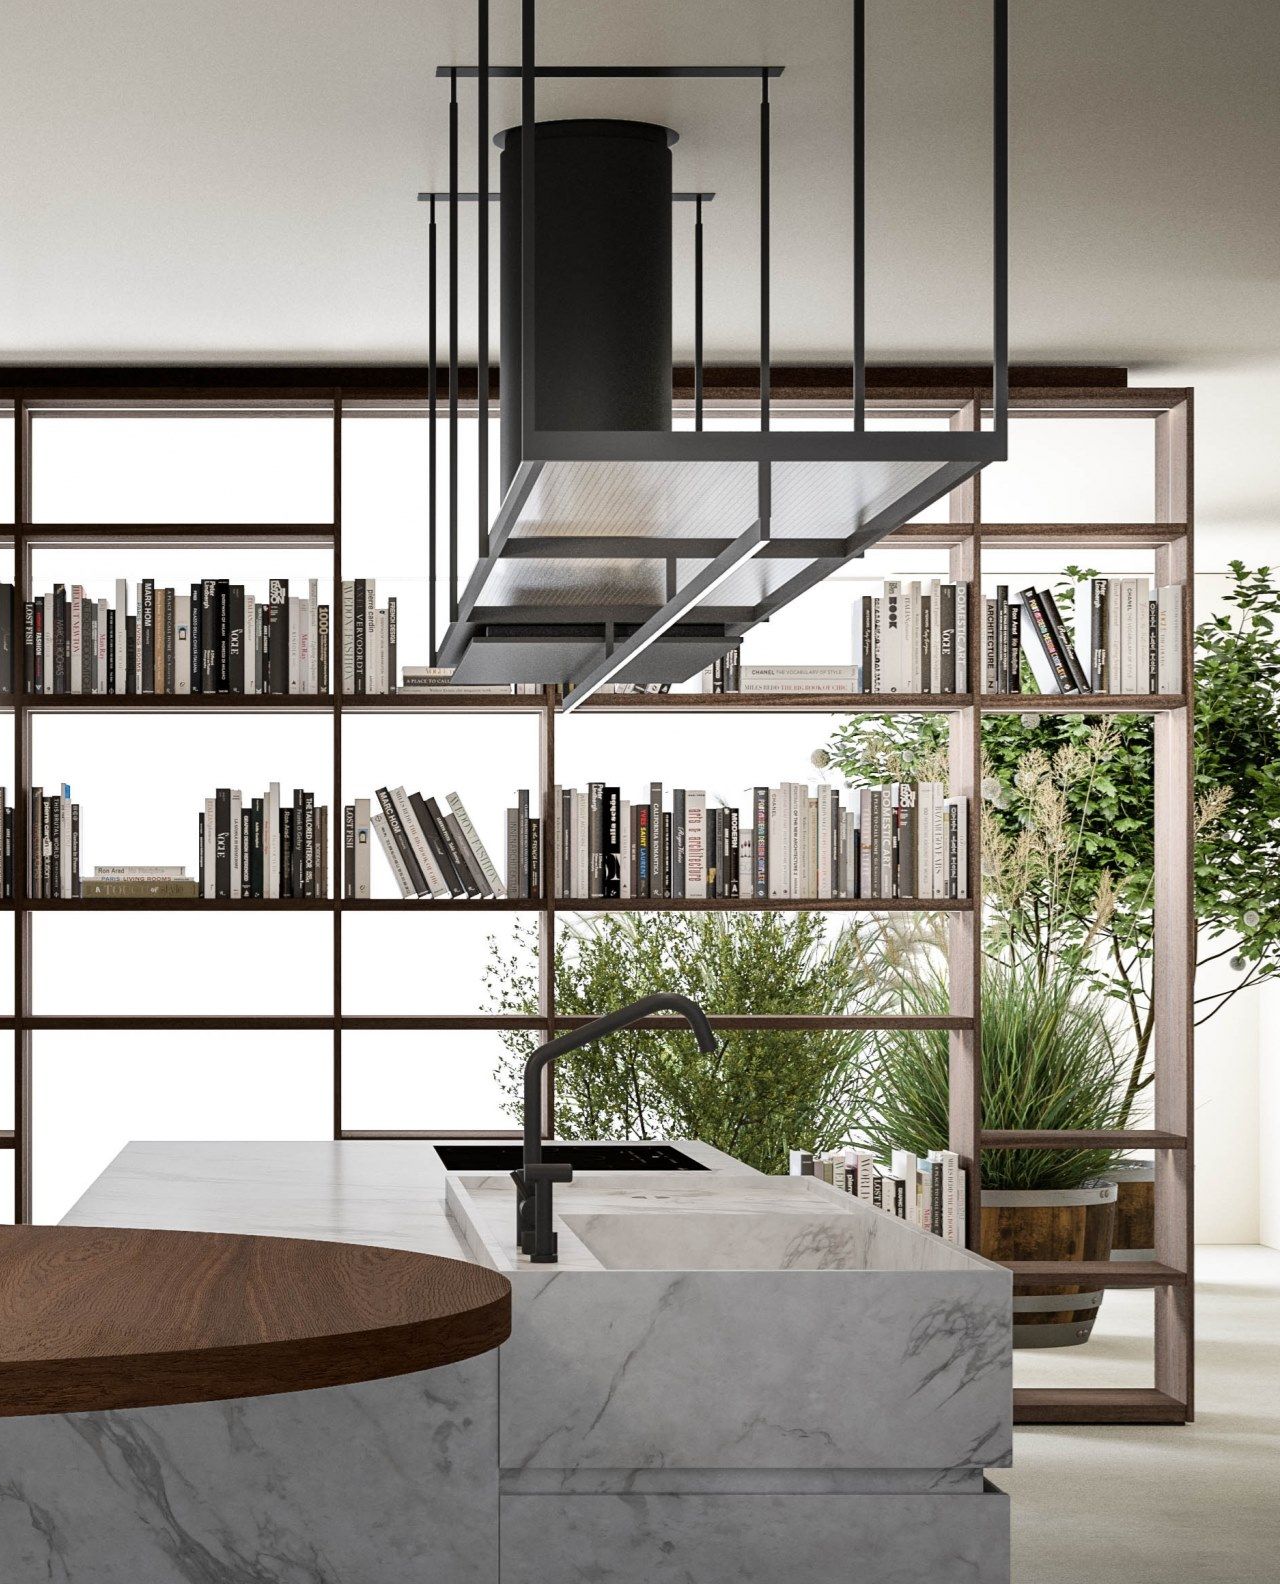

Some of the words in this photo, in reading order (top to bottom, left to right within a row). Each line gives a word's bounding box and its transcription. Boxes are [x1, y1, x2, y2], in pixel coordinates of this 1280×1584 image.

[367, 590, 375, 610] pierre
[319, 608, 328, 635] 1000
[957, 587, 965, 643] DOMESTIC
[231, 629, 239, 655] VOGUE
[957, 646, 965, 665] ART
[380, 791, 393, 815] MARC
[388, 815, 401, 834] HOM
[688, 809, 703, 823] arts
[688, 837, 704, 882] architecture
[861, 1158, 870, 1200] WORLD
